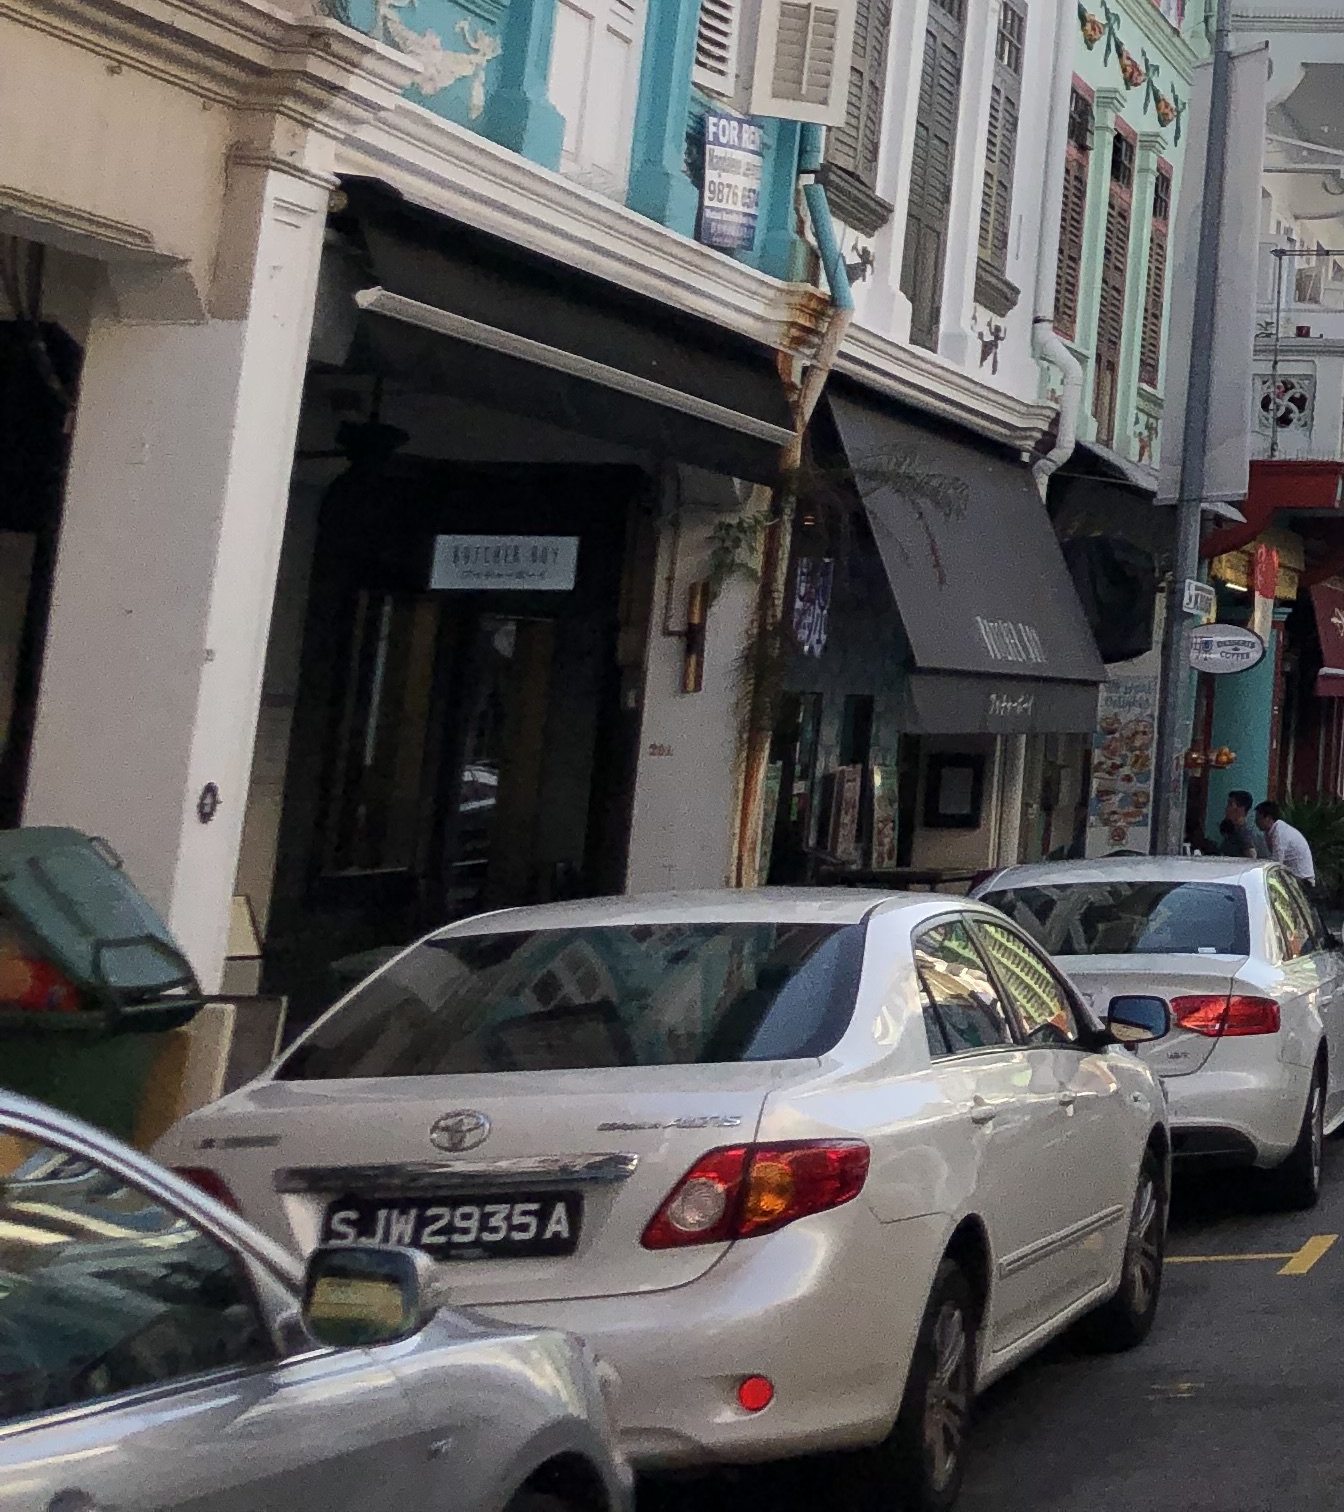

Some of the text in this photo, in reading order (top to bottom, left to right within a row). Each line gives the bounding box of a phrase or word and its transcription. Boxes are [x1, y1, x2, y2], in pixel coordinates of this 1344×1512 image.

[708, 116, 739, 145] FOR
[708, 180, 739, 206] 9876
[328, 1201, 570, 1246] SJW2935A
